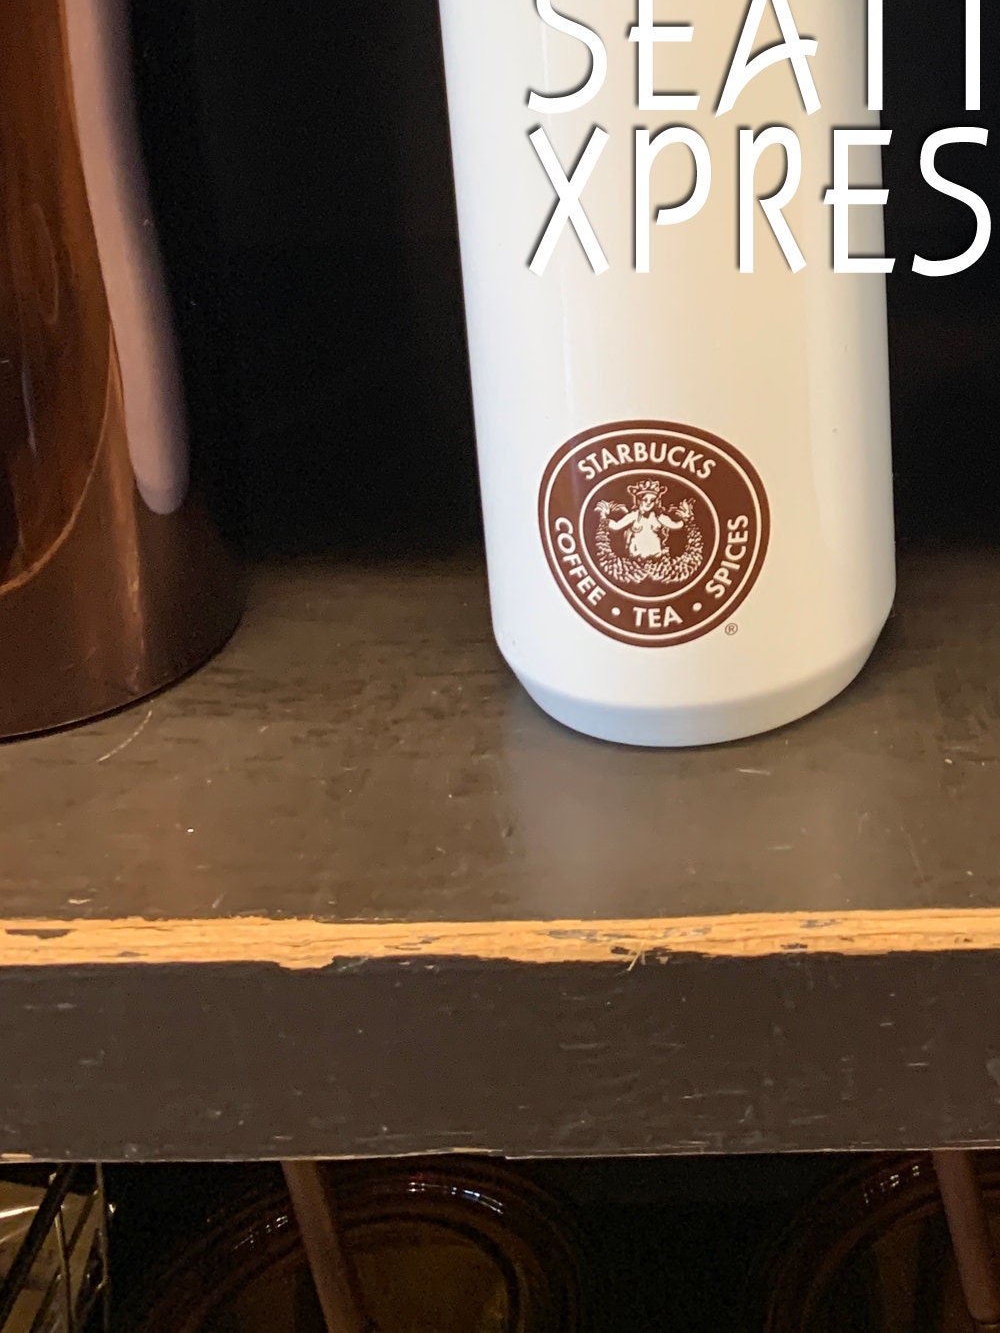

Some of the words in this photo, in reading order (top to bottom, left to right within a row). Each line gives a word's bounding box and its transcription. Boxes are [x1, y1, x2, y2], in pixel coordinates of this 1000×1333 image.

[577, 441, 717, 480] STARBUCKS
[554, 516, 607, 607] COFFEE
[632, 605, 684, 628] TEA
[704, 514, 750, 599] SPICES
